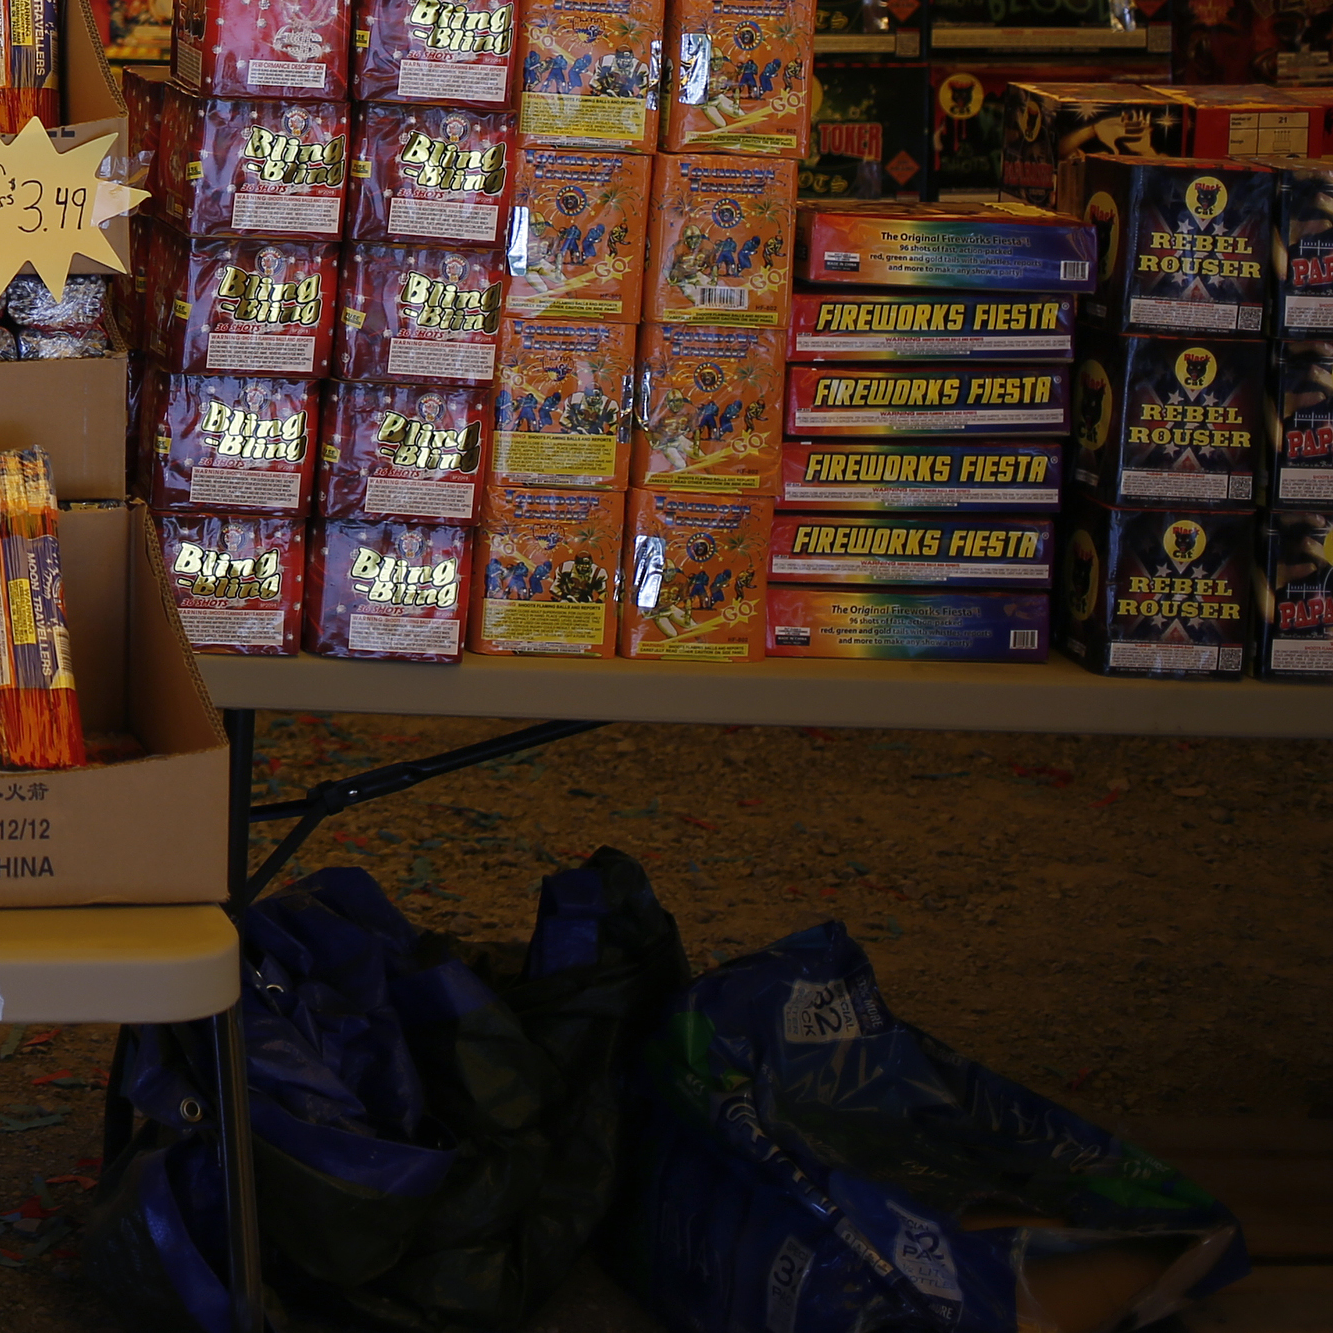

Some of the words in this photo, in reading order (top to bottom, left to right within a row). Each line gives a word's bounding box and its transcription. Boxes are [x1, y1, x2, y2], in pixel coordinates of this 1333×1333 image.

[244, 126, 346, 165] Bling
[401, 131, 507, 172] Bling
[820, 122, 882, 159] TOKER
[1150, 232, 1253, 255] REBEL
[594, 257, 628, 279] GO
[870, 254, 885, 262] red,
[887, 255, 907, 263] green
[909, 254, 923, 262] and
[925, 255, 942, 264] gold
[943, 255, 960, 263] tails
[961, 256, 977, 264] with
[1014, 259, 1042, 268] reports
[888, 264, 903, 272] and
[925, 265, 934, 273] to
[935, 265, 955, 273] make
[957, 267, 970, 275] any
[971, 267, 990, 275] show
[998, 268, 1023, 277] party!
[1138, 255, 1261, 279] ROUSER
[400, 271, 503, 311] Bling
[749, 269, 783, 291] GO
[816, 304, 965, 330] FIREWORKS
[973, 303, 1060, 330] FIESTA
[814, 378, 960, 405] FIREWORKS
[967, 377, 1052, 404] FIESTA
[202, 400, 307, 441] Bling
[1140, 404, 1243, 424] REBEL
[376, 410, 481, 451] Bling
[1128, 427, 1251, 448] ROUSER
[805, 454, 951, 482] FIREWORKS
[960, 455, 1049, 483] FIESTA
[793, 527, 941, 555] FIREWORKS
[949, 530, 1039, 558] FIESTA
[351, 546, 457, 584] Bling
[1129, 577, 1233, 597] REBEL
[27, 551, 38, 592] MOON
[33, 596, 52, 677] TRAVELLERS
[721, 599, 755, 622] GO
[831, 604, 848, 615] The
[850, 605, 890, 617] Original
[891, 606, 941, 617] Fireworks
[1117, 599, 1241, 620] ROUSER
